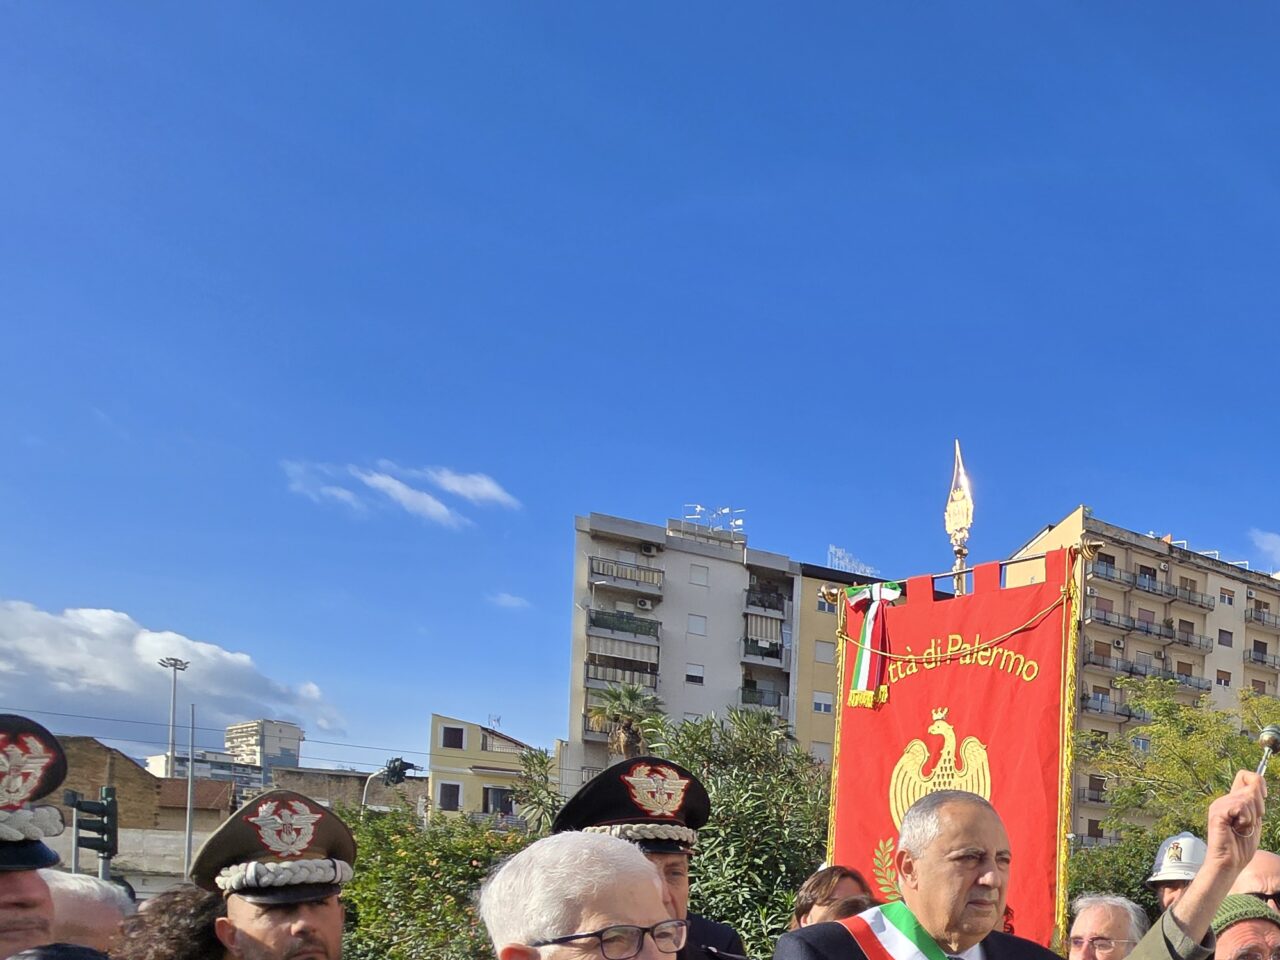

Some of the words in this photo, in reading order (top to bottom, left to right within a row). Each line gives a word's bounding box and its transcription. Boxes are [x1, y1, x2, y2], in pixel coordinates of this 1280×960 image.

[888, 646, 918, 683] ttà
[923, 639, 942, 670] di
[947, 634, 1040, 682] Palermo
